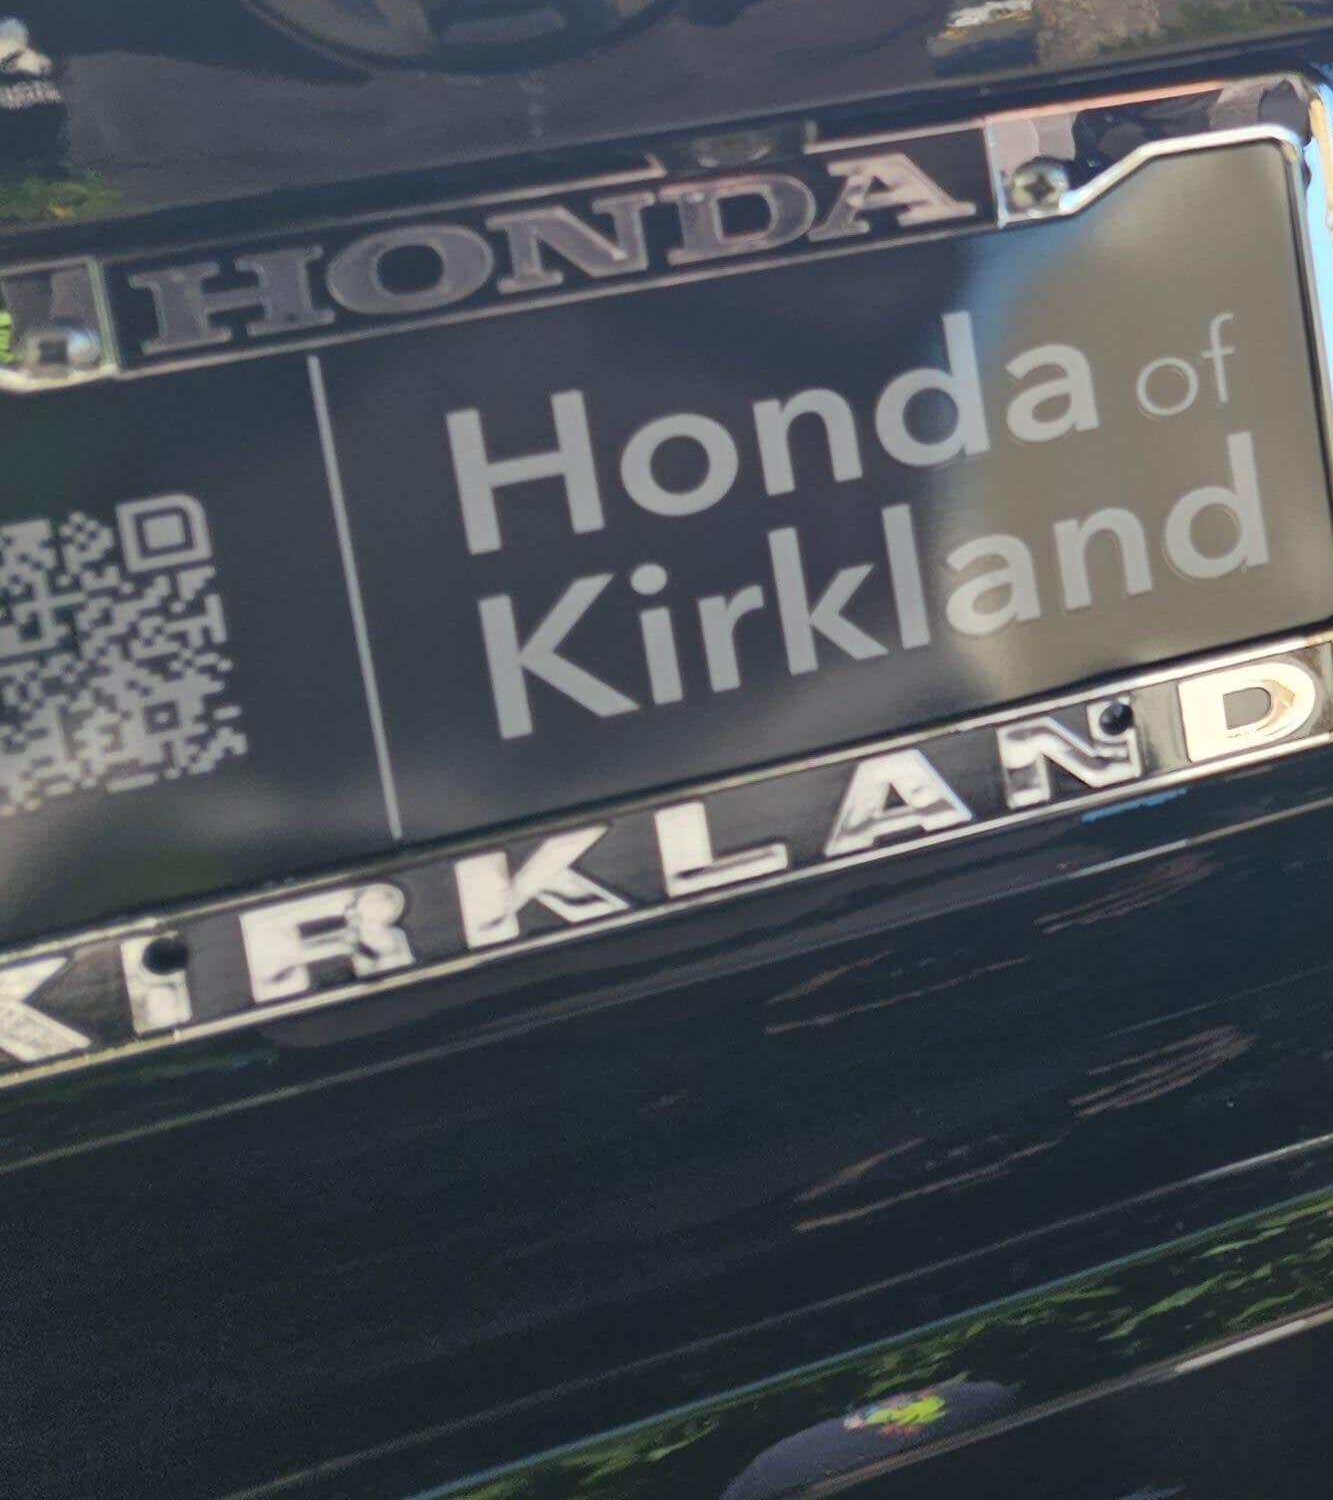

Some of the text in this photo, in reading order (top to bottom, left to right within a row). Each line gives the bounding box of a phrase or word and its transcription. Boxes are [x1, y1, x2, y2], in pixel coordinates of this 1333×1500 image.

[128, 151, 976, 354] HONDA
[446, 311, 1235, 555] Honda of
[476, 432, 1271, 740] Kirkland
